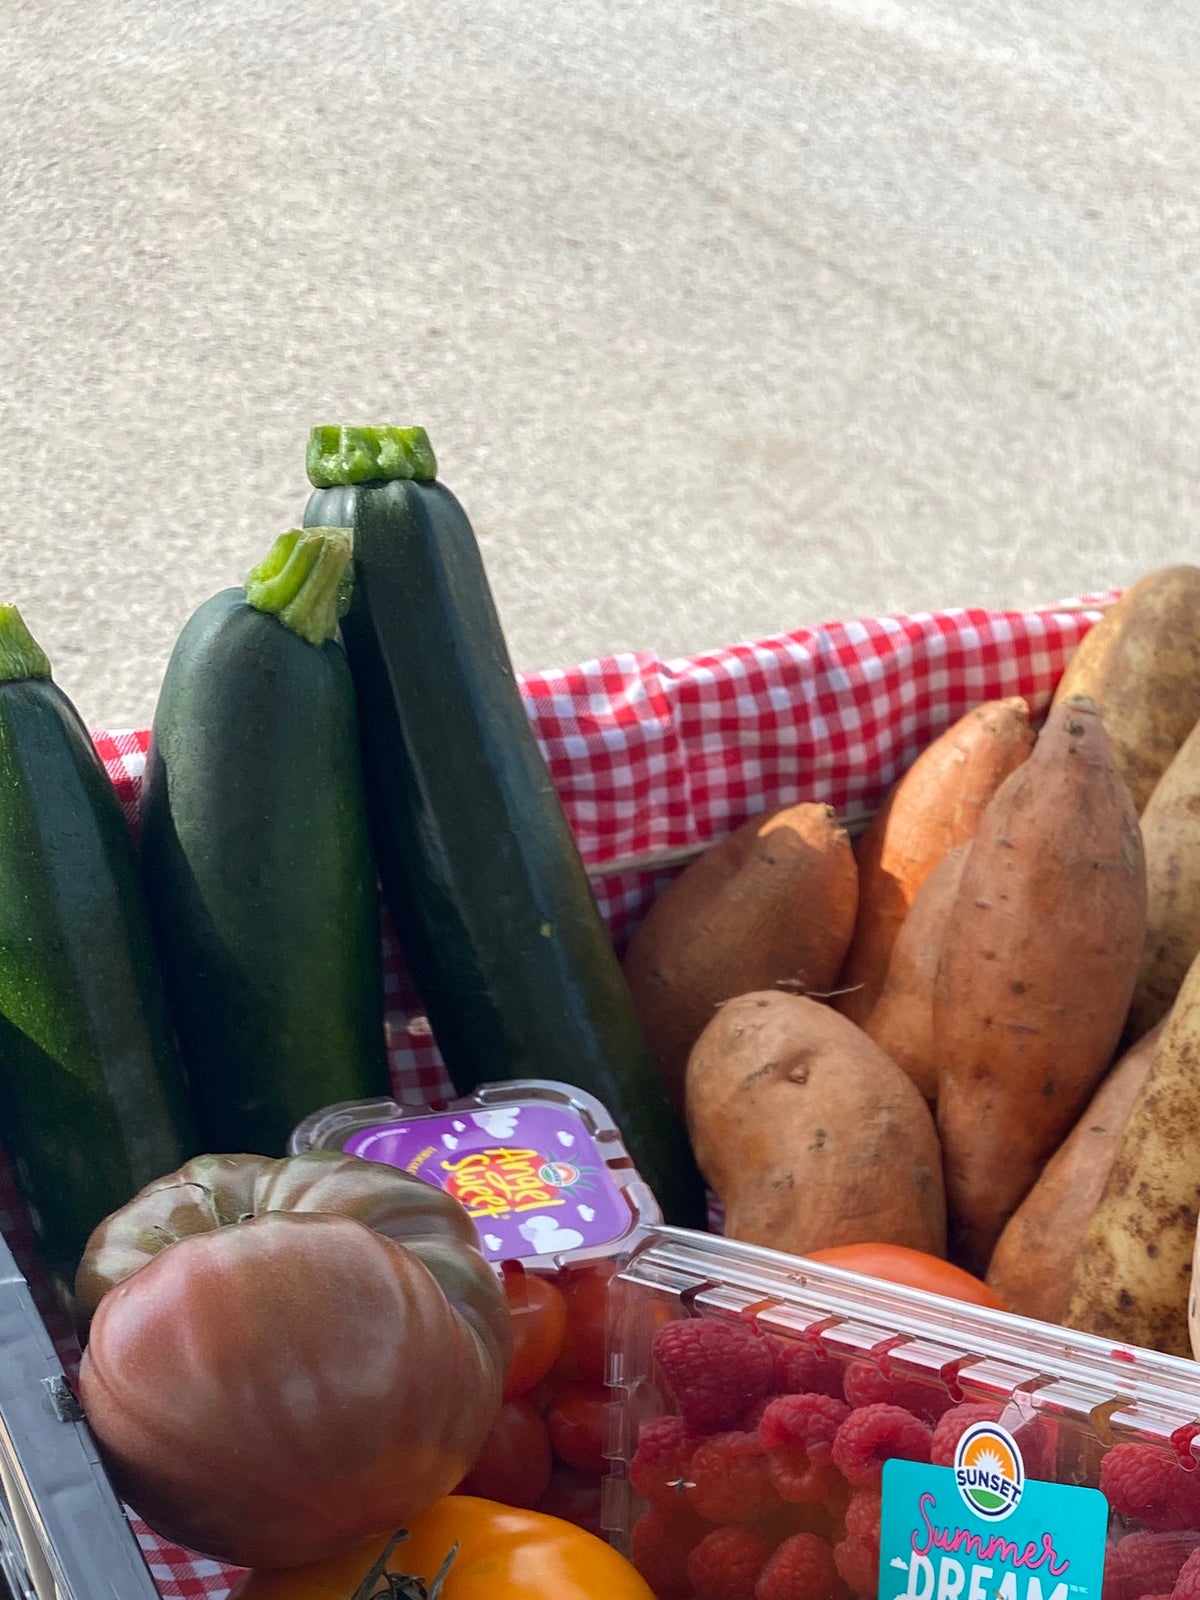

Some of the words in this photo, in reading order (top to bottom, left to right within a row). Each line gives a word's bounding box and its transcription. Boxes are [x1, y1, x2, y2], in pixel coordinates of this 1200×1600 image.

[440, 1154, 511, 1219] Sweet
[484, 1148, 566, 1212] Angel
[957, 1469, 1022, 1505] SUNSET
[911, 1491, 1071, 1576] Summer
